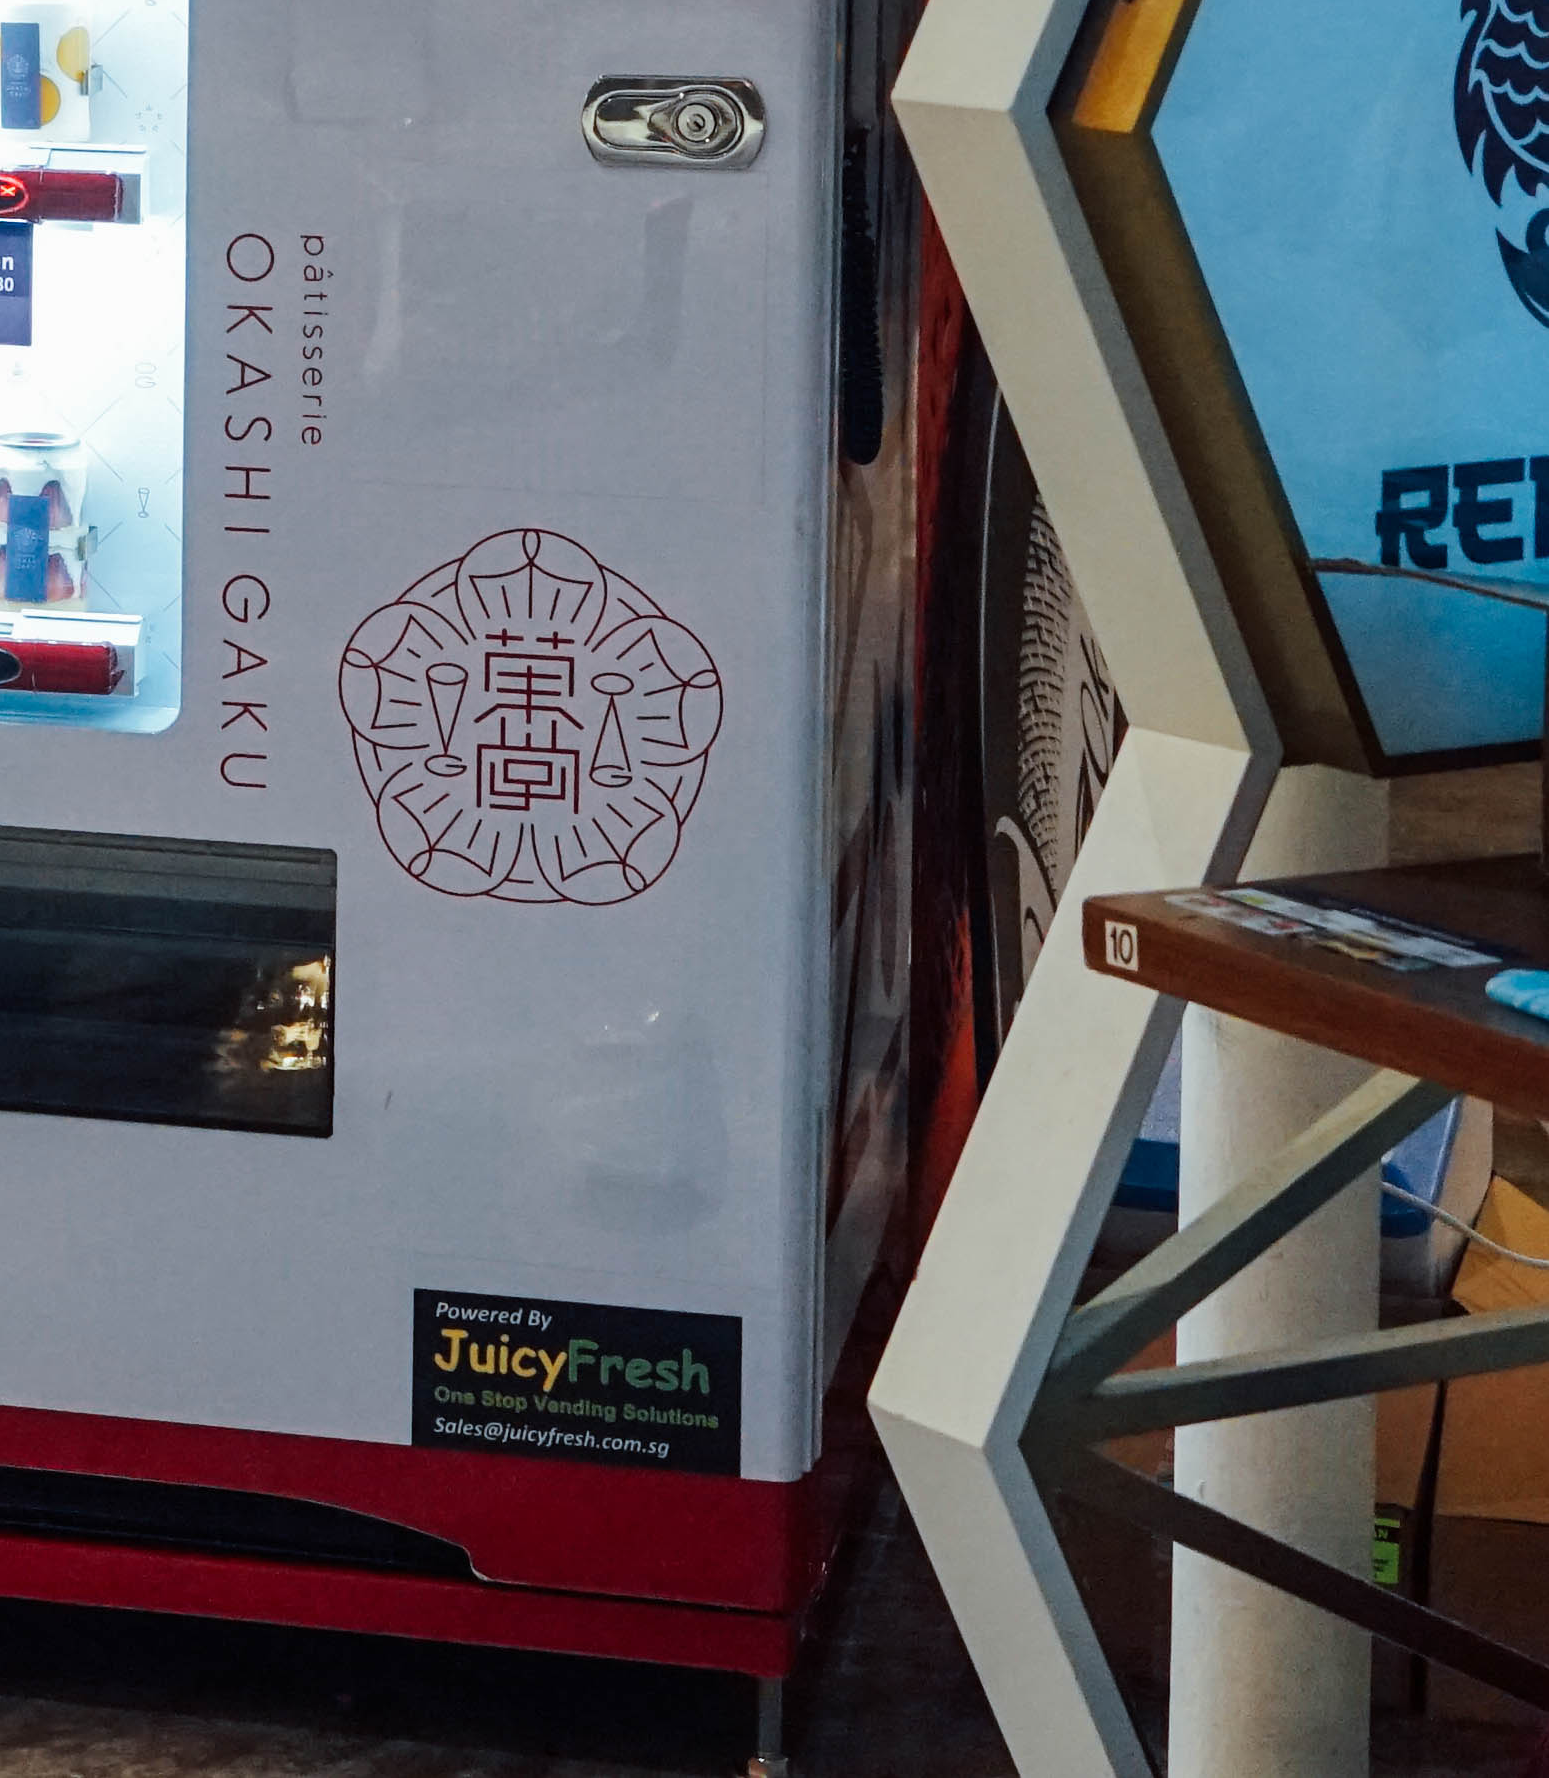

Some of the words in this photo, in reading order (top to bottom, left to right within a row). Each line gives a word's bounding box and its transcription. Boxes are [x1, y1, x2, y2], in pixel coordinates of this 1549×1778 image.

[300, 234, 337, 448] pâtisserie
[222, 232, 276, 535] OKASHI
[219, 573, 271, 790] GAKU
[1109, 928, 1134, 966] 10
[435, 1302, 523, 1325] Powered
[528, 1310, 552, 1331] By
[433, 1328, 711, 1395] JuicyFresh
[434, 1385, 475, 1406] One
[481, 1390, 527, 1413] Stop
[534, 1395, 617, 1423] Vending
[622, 1404, 720, 1429] Solutions
[433, 1416, 670, 1459] Sales@juicyfresh.com.sg
